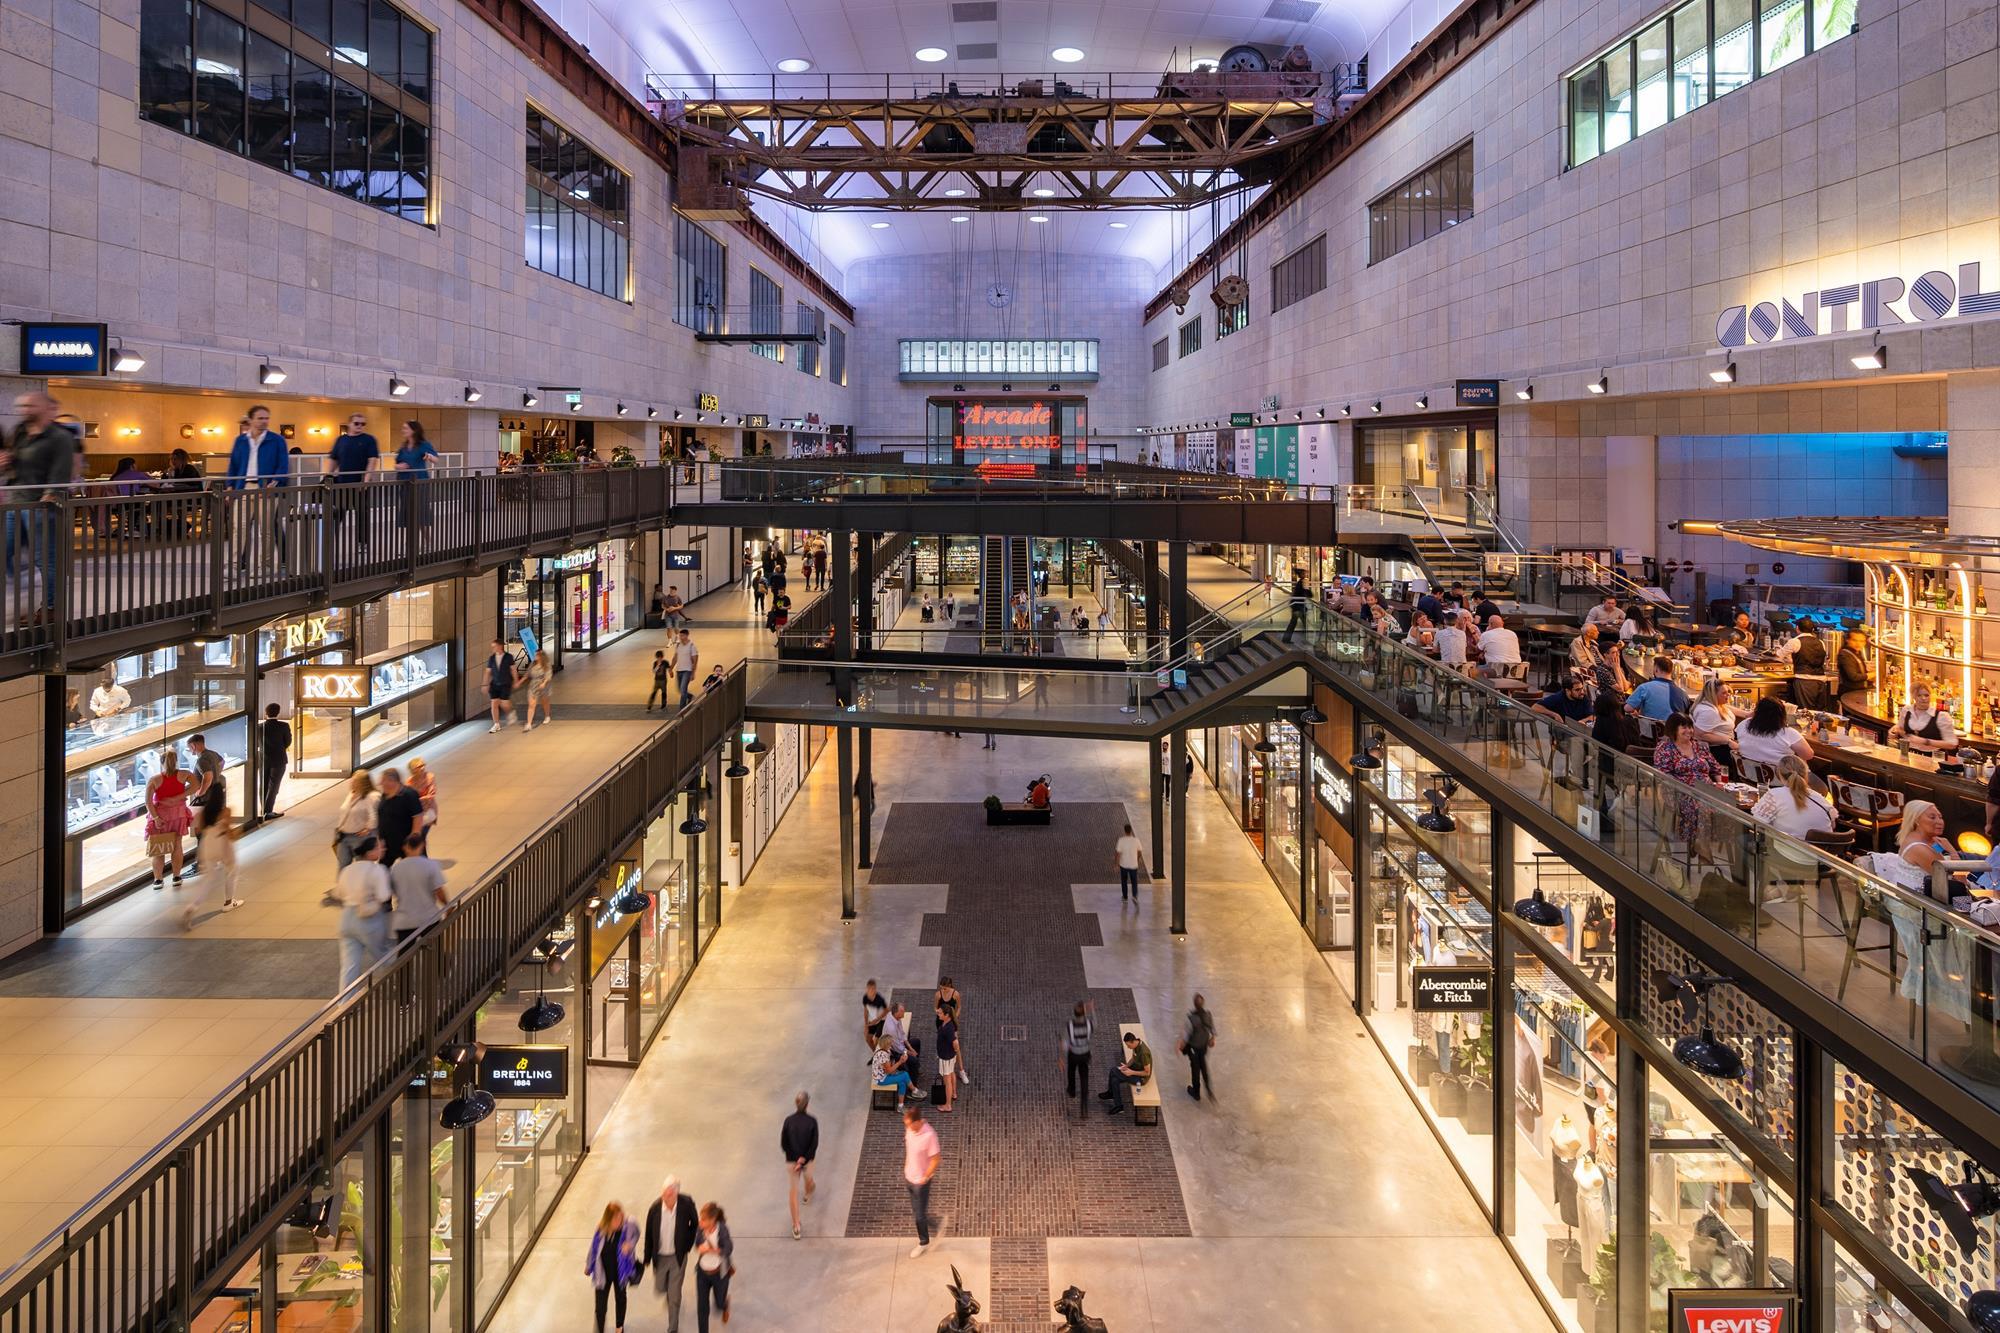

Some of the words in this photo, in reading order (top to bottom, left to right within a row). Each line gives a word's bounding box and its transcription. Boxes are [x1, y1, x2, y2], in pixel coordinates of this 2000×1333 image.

[1716, 261, 2000, 348] CONTROL
[33, 342, 94, 356] MANNA
[964, 402, 1052, 425] Arcade
[1232, 416, 1250, 424] BOUNCE
[954, 435, 1015, 449] LEVEL
[1020, 435, 1061, 449] ONE
[286, 616, 329, 648] ROX
[303, 675, 363, 699] ROX
[1419, 978, 1487, 990] Abercrombie
[1433, 993, 1443, 1003] &
[1444, 991, 1473, 1003] Fitch
[493, 1070, 553, 1079] BREITLING
[513, 1079, 531, 1087] 1884
